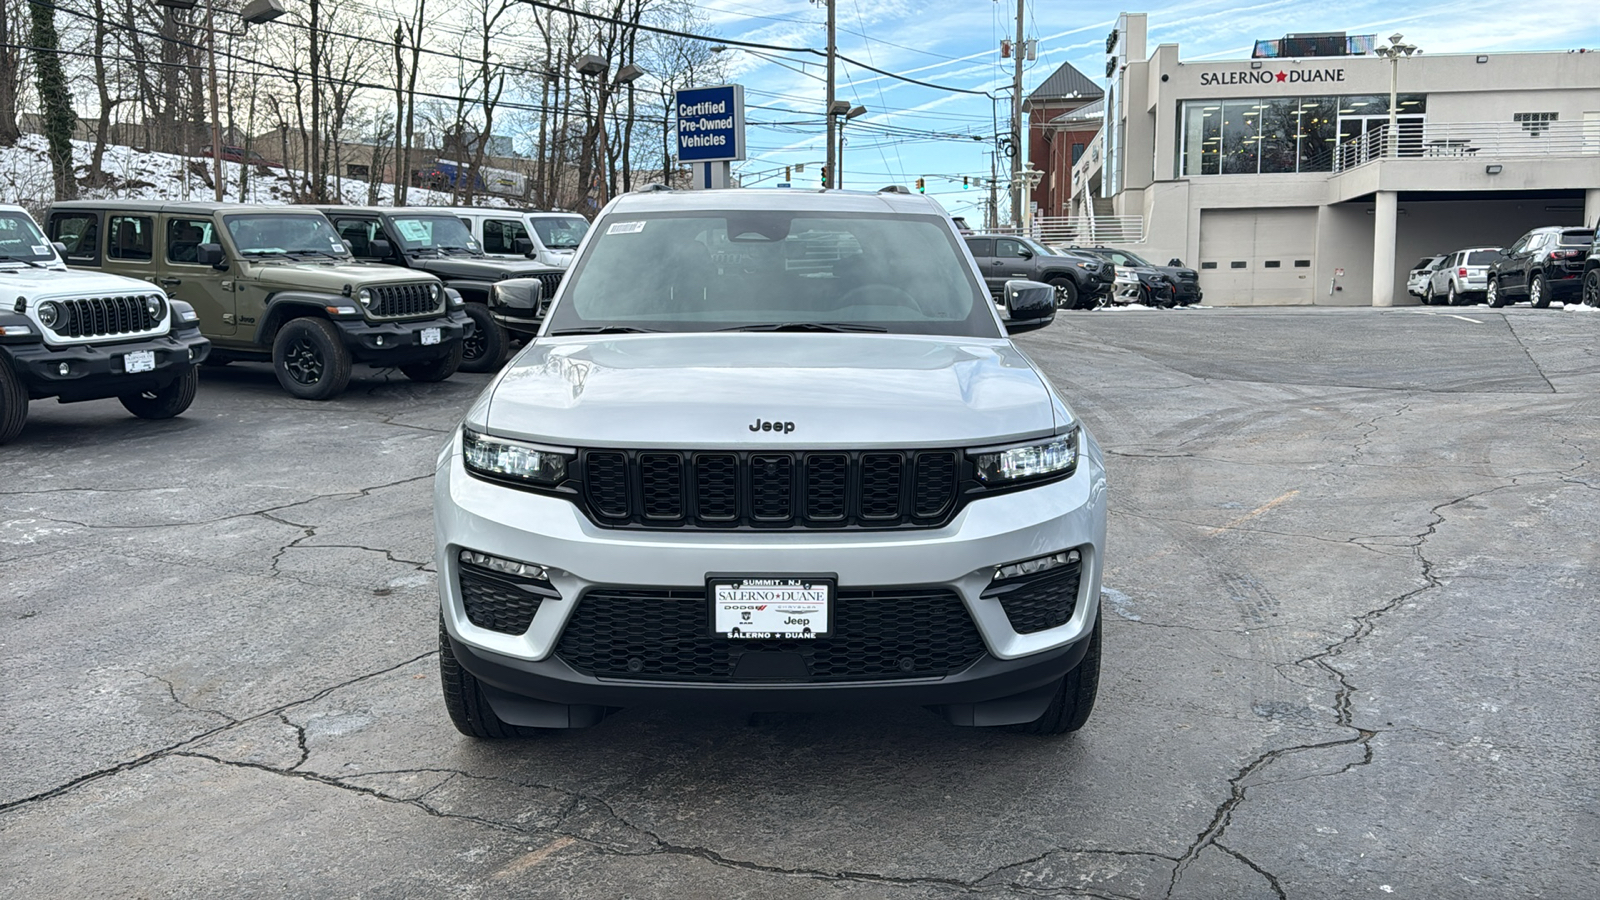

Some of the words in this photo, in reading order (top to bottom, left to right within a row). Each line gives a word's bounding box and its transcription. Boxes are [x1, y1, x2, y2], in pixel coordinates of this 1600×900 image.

[1200, 71, 1273, 86] SALERNO
[1289, 68, 1345, 82] DUANE
[679, 100, 725, 116] Certified
[680, 116, 732, 132] Pre-Owned
[681, 133, 726, 148] Vehicles
[748, 418, 796, 435] Jeep
[718, 591, 775, 601] SALERNO
[781, 591, 825, 601] DUANE
[783, 616, 810, 626] Jeep
